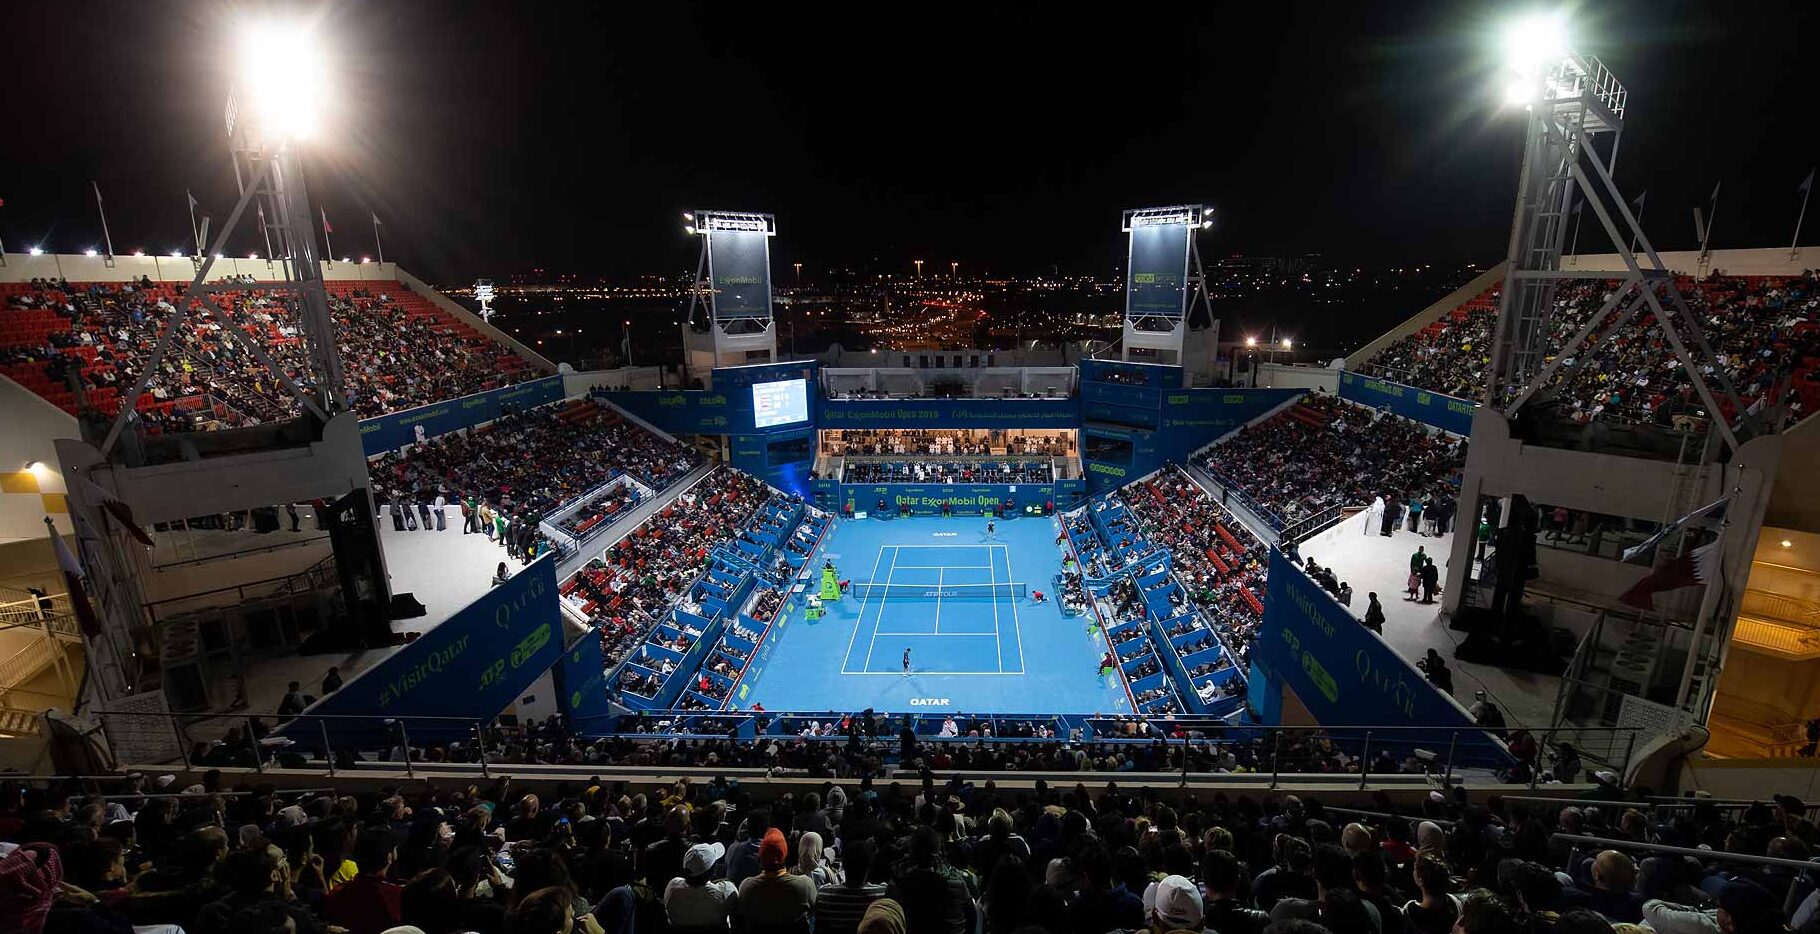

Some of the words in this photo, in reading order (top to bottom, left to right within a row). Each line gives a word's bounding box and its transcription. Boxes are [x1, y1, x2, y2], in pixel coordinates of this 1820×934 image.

[719, 275, 762, 285] ExxonMobil
[847, 410, 895, 420] ExxonMobil
[895, 494, 919, 506] Qatar
[921, 496, 976, 508] ExxonMobil
[978, 494, 999, 507] Open
[1285, 581, 1337, 638] #VisitQatar
[378, 634, 470, 708] #VisitQatar
[910, 698, 950, 707] QATAR
